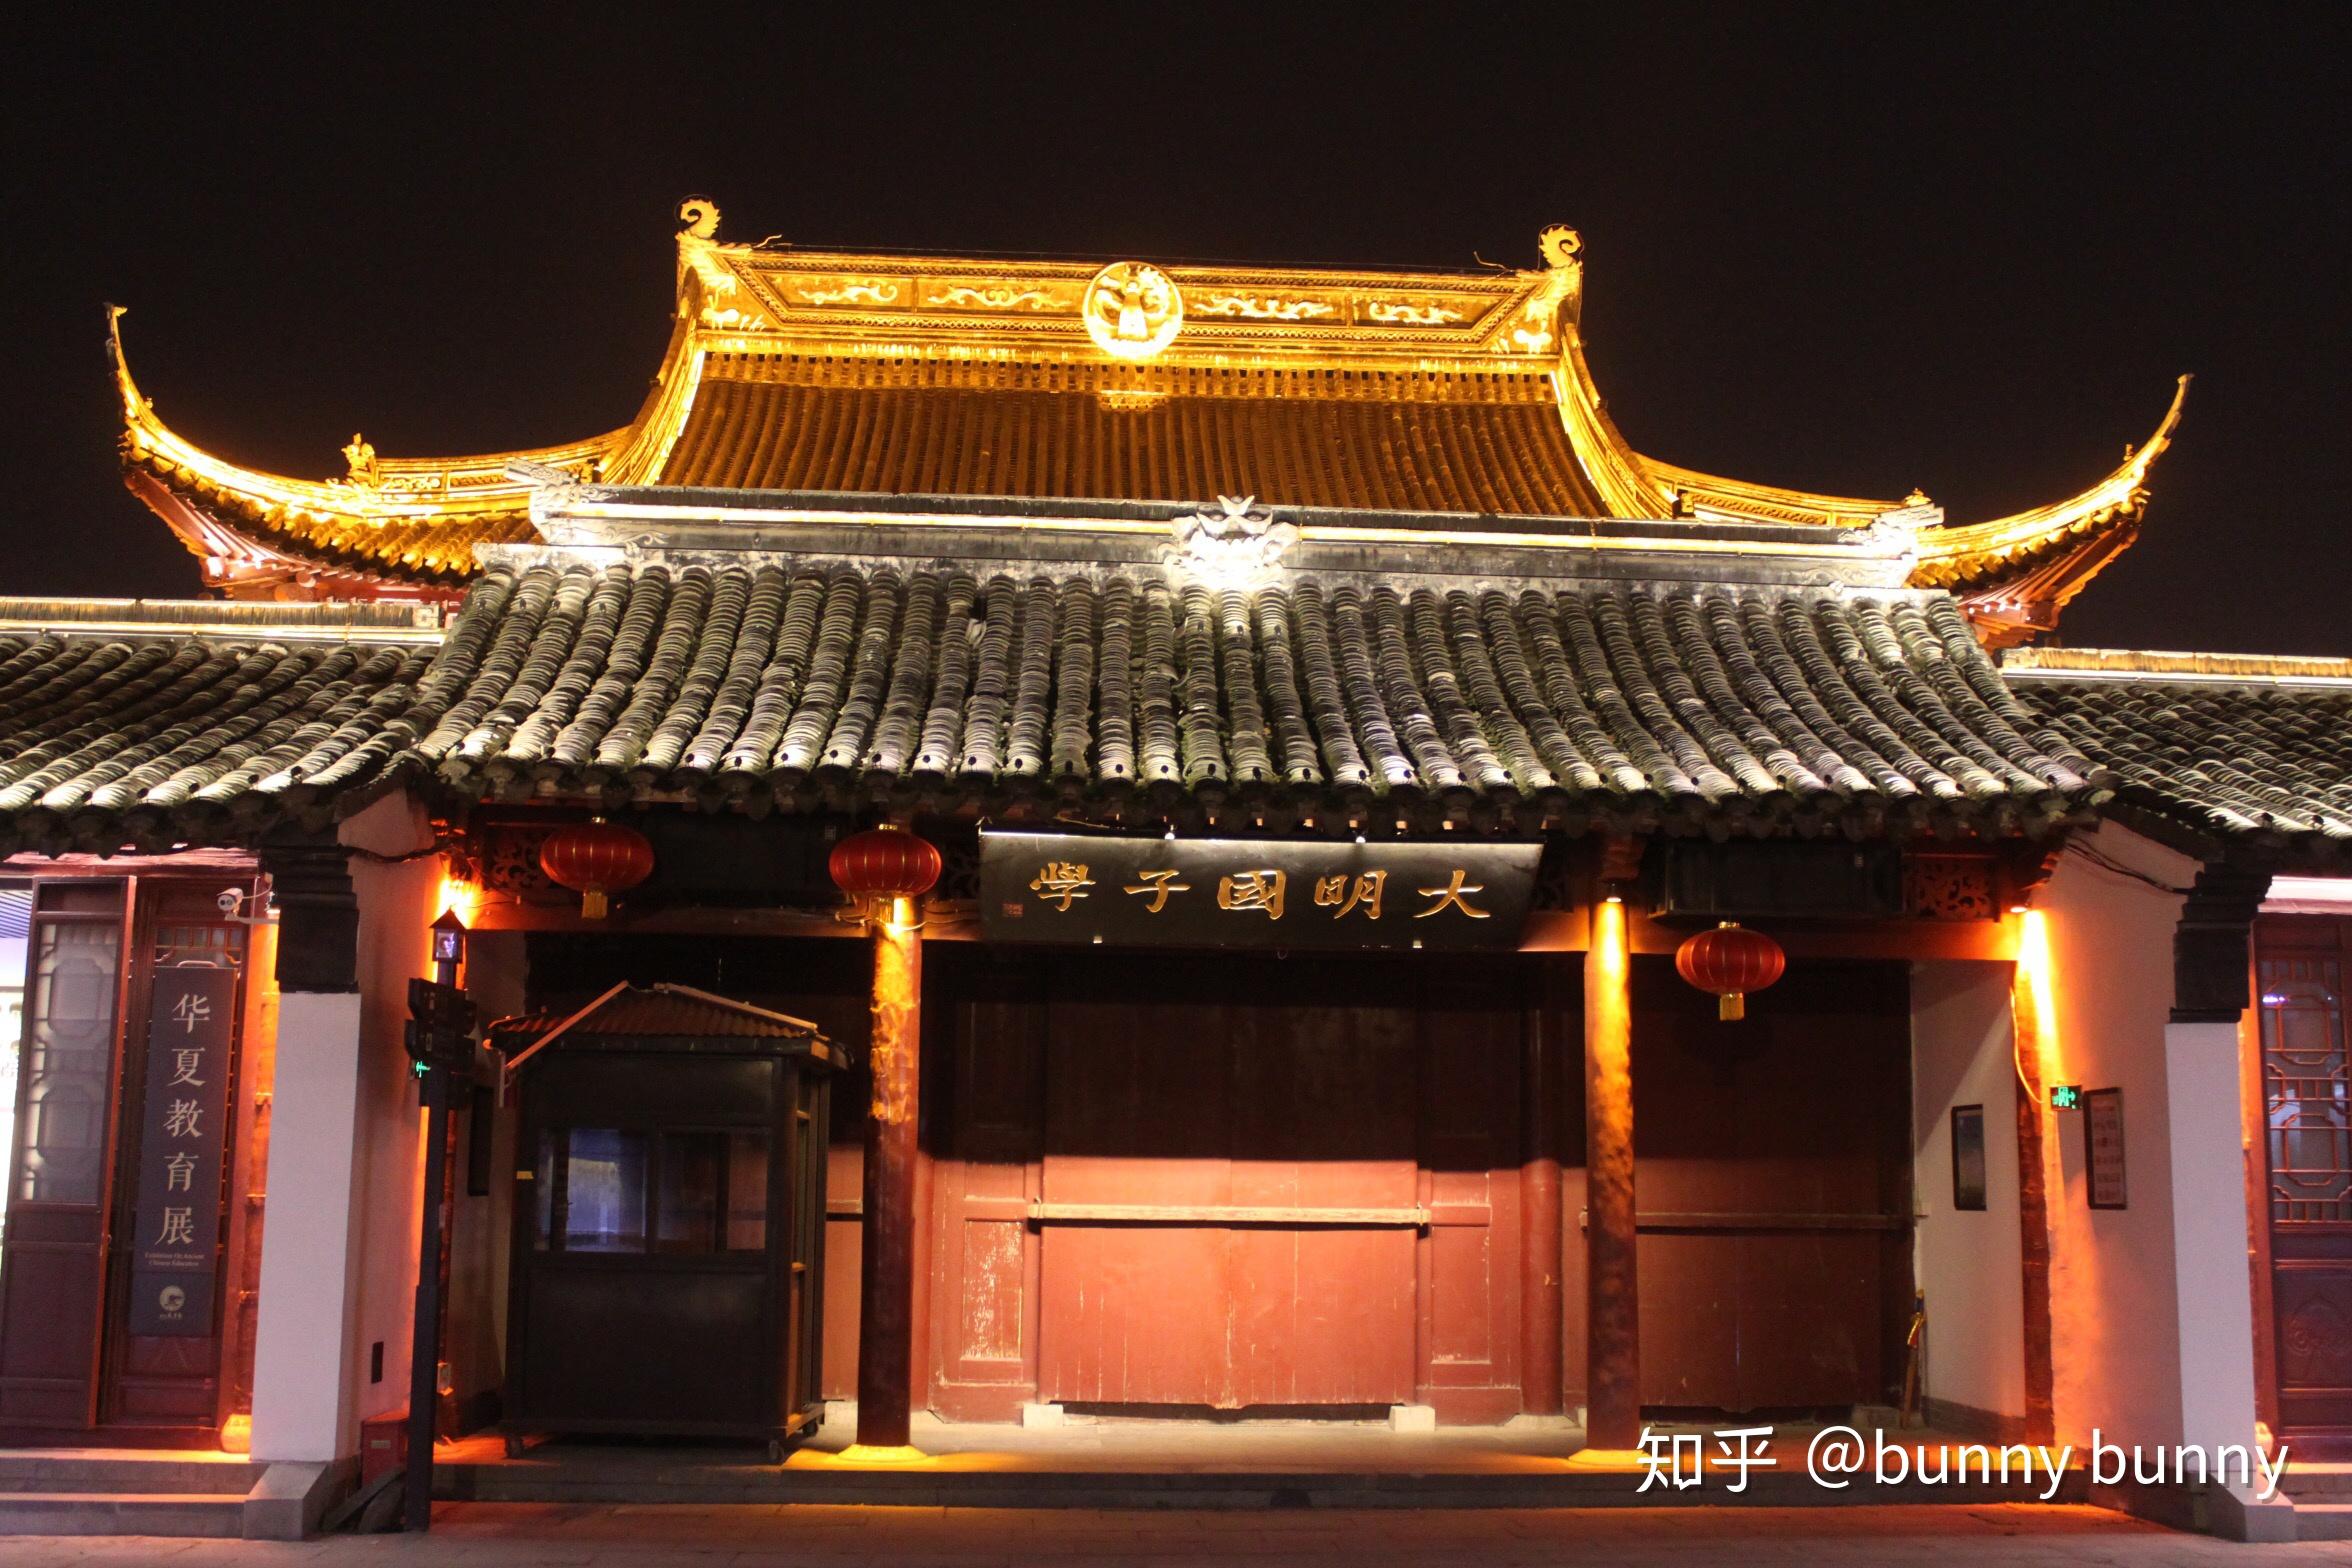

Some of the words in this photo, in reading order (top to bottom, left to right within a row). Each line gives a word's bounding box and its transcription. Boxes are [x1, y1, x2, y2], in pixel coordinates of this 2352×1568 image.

[156, 993, 211, 1246] 华夏教育展
